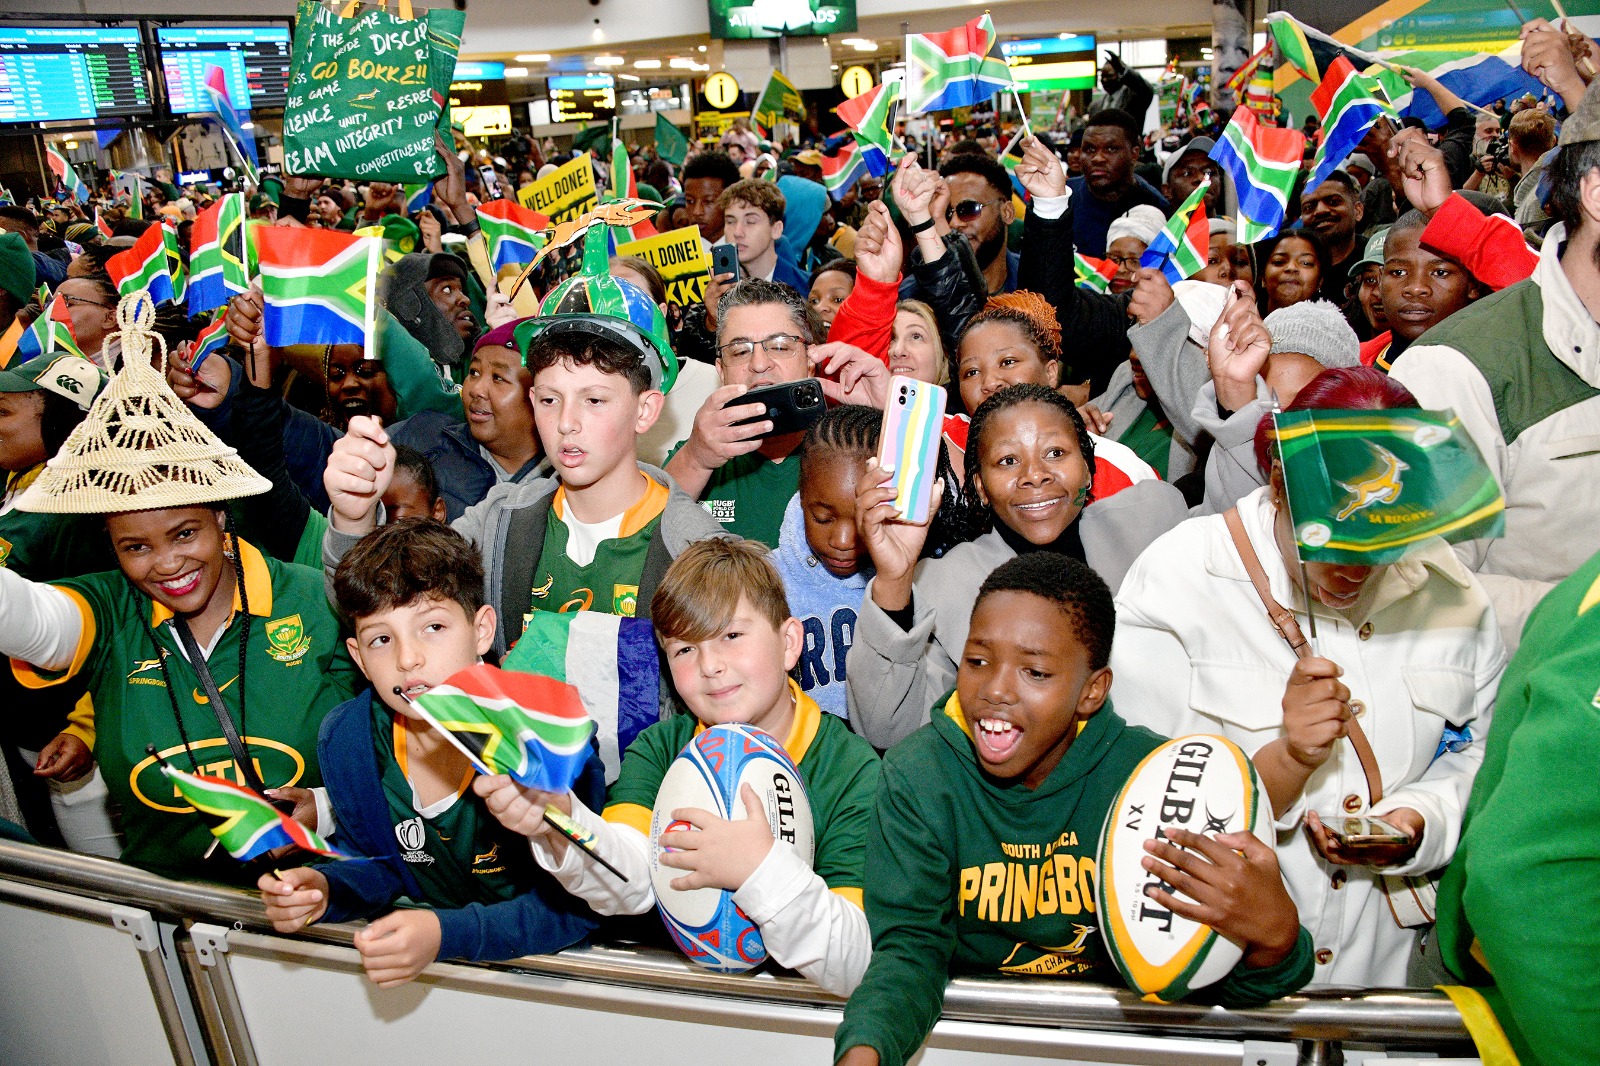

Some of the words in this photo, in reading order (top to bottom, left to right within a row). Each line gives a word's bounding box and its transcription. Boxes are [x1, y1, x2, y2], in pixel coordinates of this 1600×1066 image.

[349, 12, 381, 36] GAME
[321, 33, 345, 48] THE
[334, 38, 361, 60] PRIDE
[311, 61, 338, 80] GO
[347, 58, 428, 84] BOKKE!!
[308, 80, 341, 100] GAME
[338, 112, 367, 129] UNITY
[335, 116, 403, 153] INTEGRITY
[285, 141, 338, 176] TEAM
[524, 184, 552, 212] WELL
[554, 165, 589, 200] DONE!
[658, 239, 699, 267] DONE!
[713, 499, 736, 507] RUGBY
[1001, 842, 1041, 859] SOUTH
[958, 853, 1097, 923] PRINGBO
